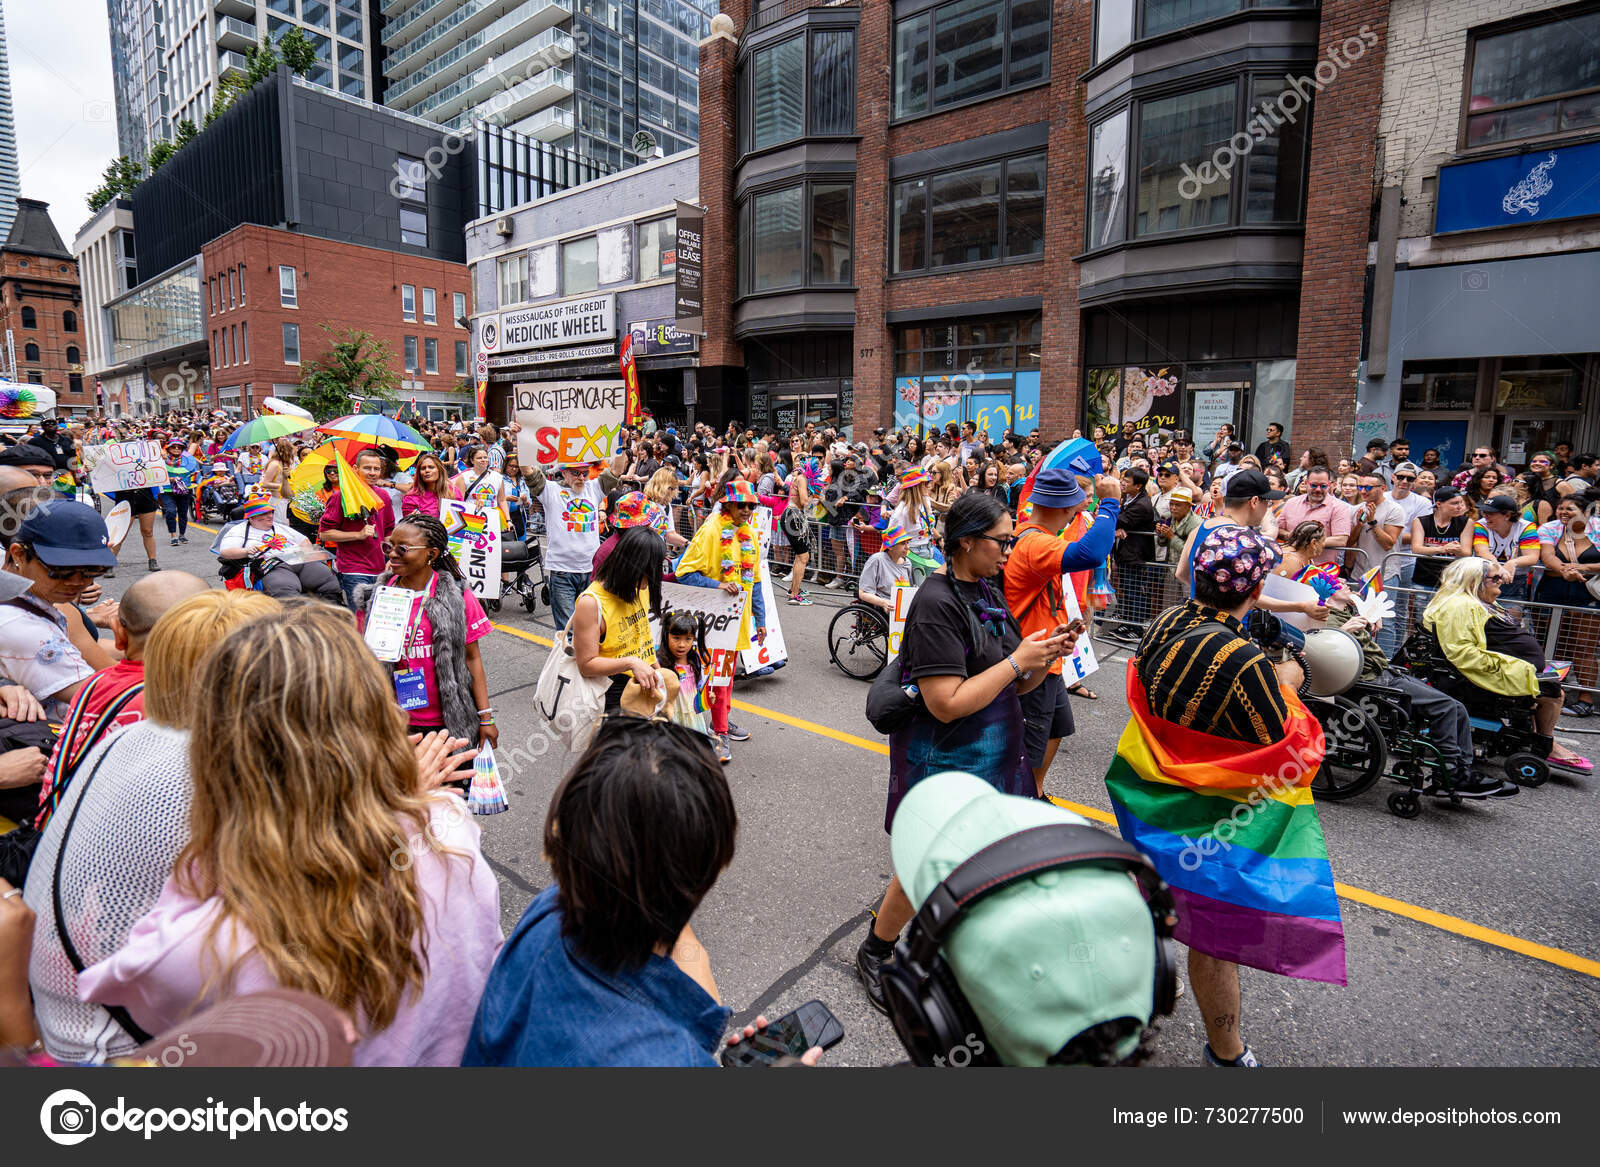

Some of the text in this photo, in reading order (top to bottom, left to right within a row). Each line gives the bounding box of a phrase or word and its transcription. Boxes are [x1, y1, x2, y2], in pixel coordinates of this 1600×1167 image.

[679, 228, 700, 242] OFFICE
[678, 249, 700, 263] LEASE
[506, 300, 606, 325] MISSISSAUGAS OF THE CREDIT
[506, 321, 559, 344] MEDICINE
[561, 314, 607, 337] WHEEL
[527, 354, 546, 362] EDIBLES
[548, 350, 575, 360] PRE-ROLLS
[577, 345, 613, 357] ACCESSORIES
[861, 349, 873, 358] 577
[109, 441, 161, 465] LOUD
[135, 458, 147, 471] &
[118, 466, 167, 489] PROUD
